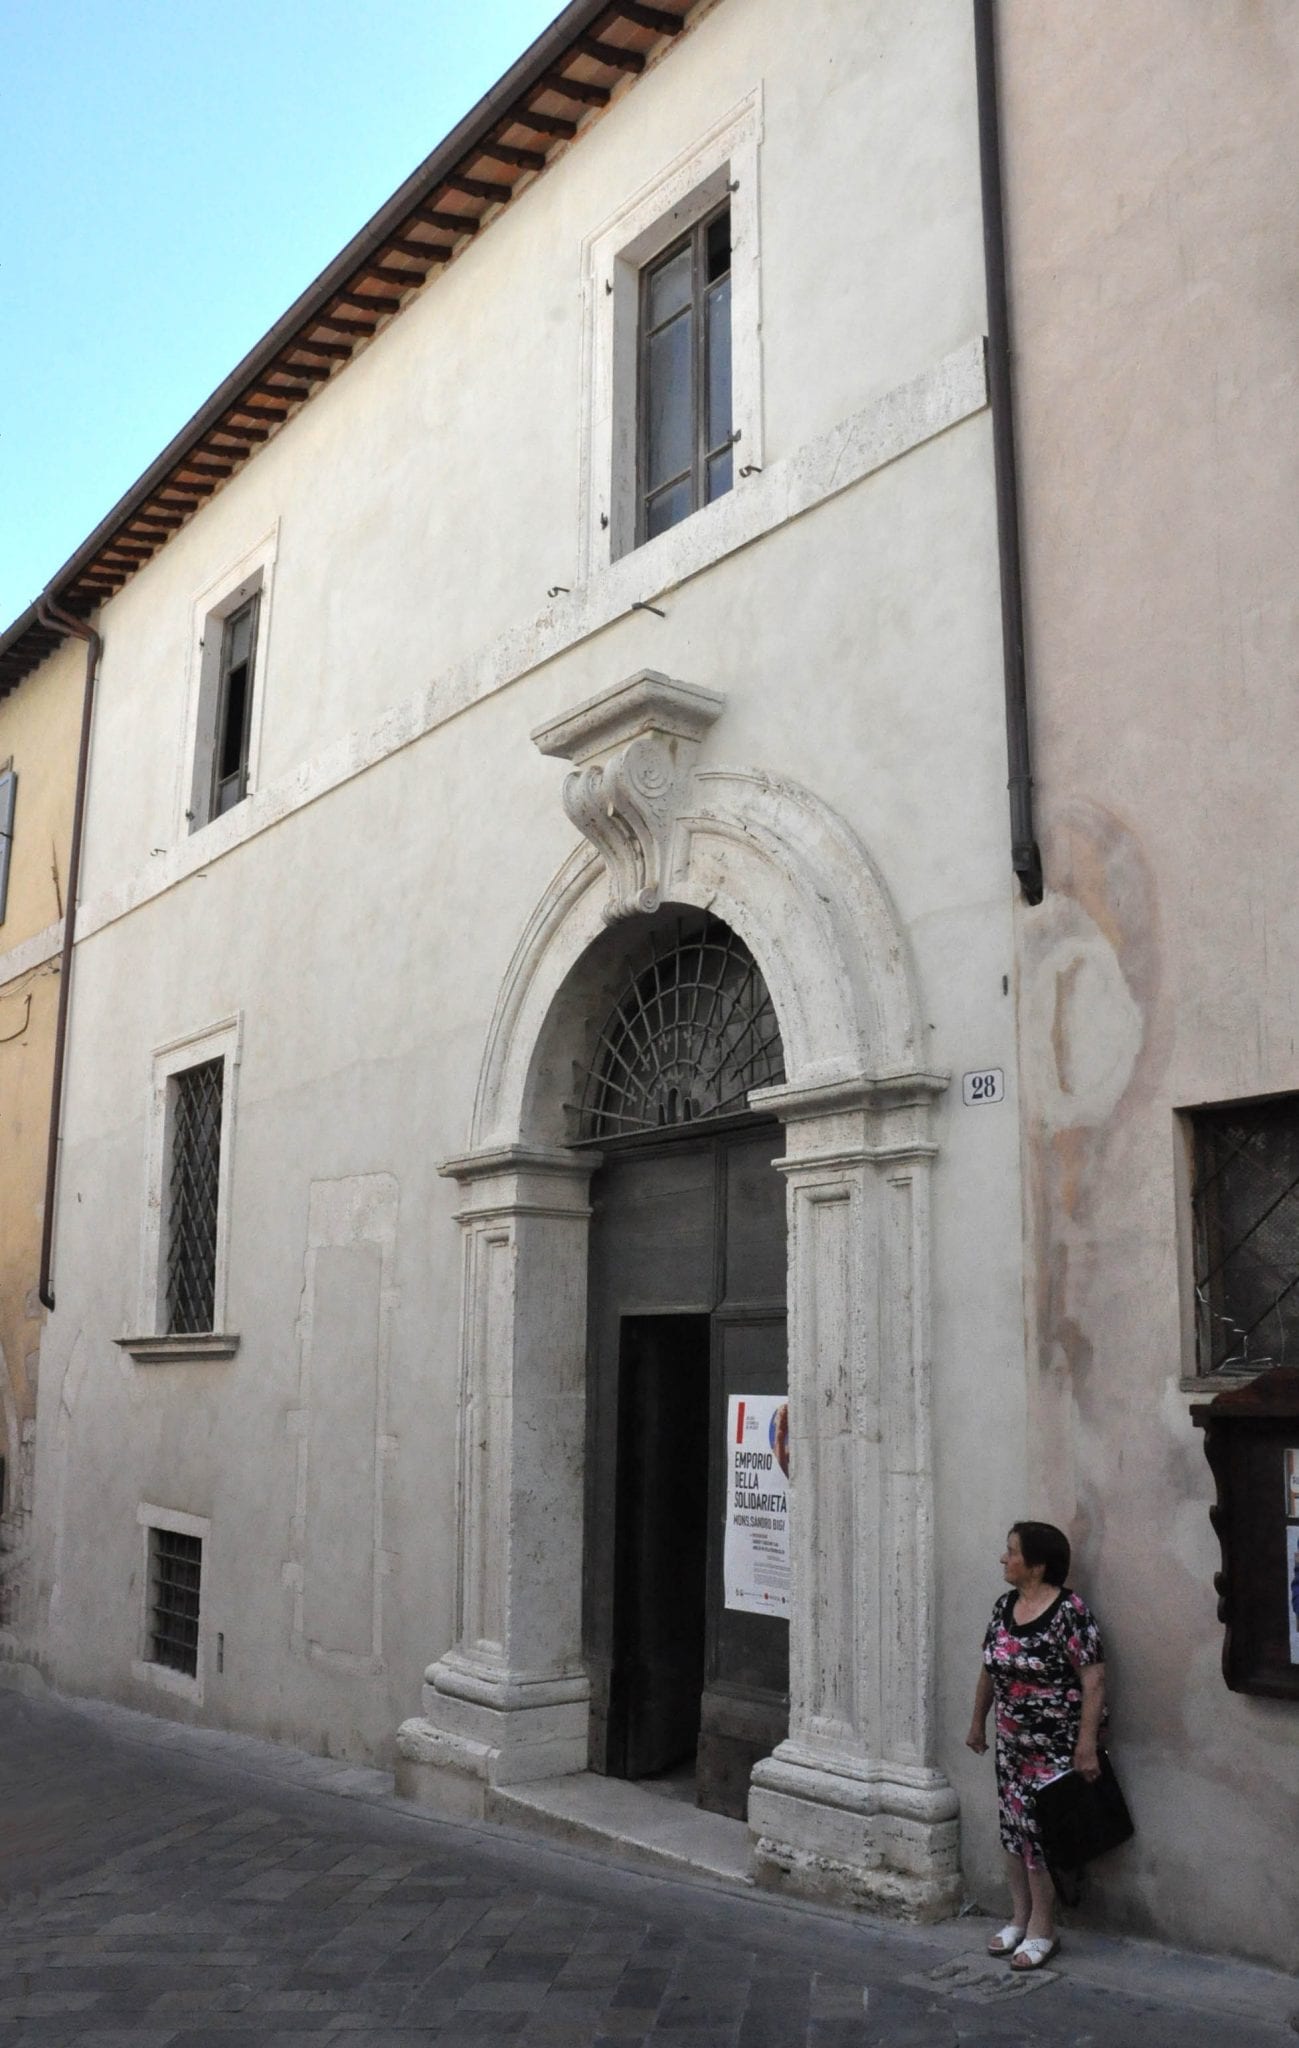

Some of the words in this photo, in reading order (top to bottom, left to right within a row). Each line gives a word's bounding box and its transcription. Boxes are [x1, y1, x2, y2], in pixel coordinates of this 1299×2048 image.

[972, 1074, 996, 1099] 28
[735, 1451, 773, 1471] EMPORIO
[735, 1471, 759, 1490] DELLA
[734, 1491, 787, 1513] SOLIDARIETÀ
